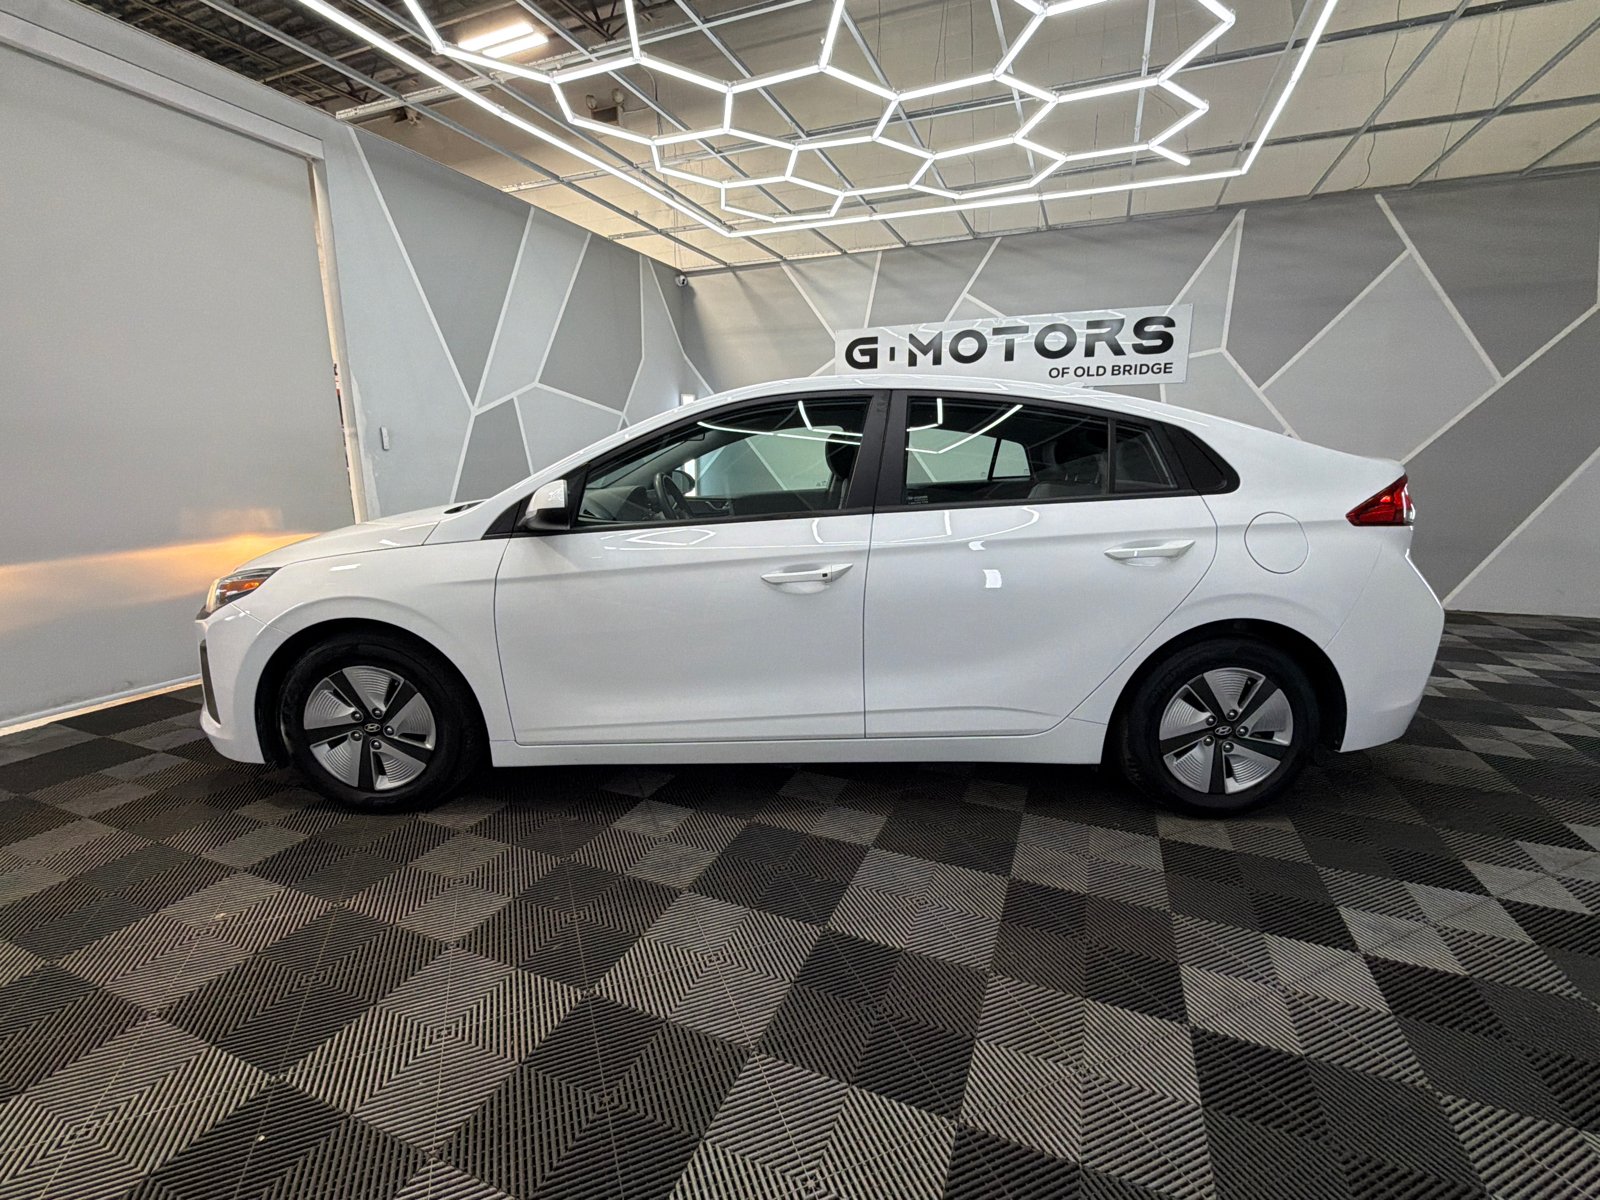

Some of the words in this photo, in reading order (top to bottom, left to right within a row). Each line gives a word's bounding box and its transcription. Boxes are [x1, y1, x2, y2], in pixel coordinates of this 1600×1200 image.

[908, 316, 1176, 367] MOTORS
[1048, 367, 1070, 379] OF
[1073, 365, 1107, 378] OLD
[1111, 362, 1174, 376] BRIDGE
